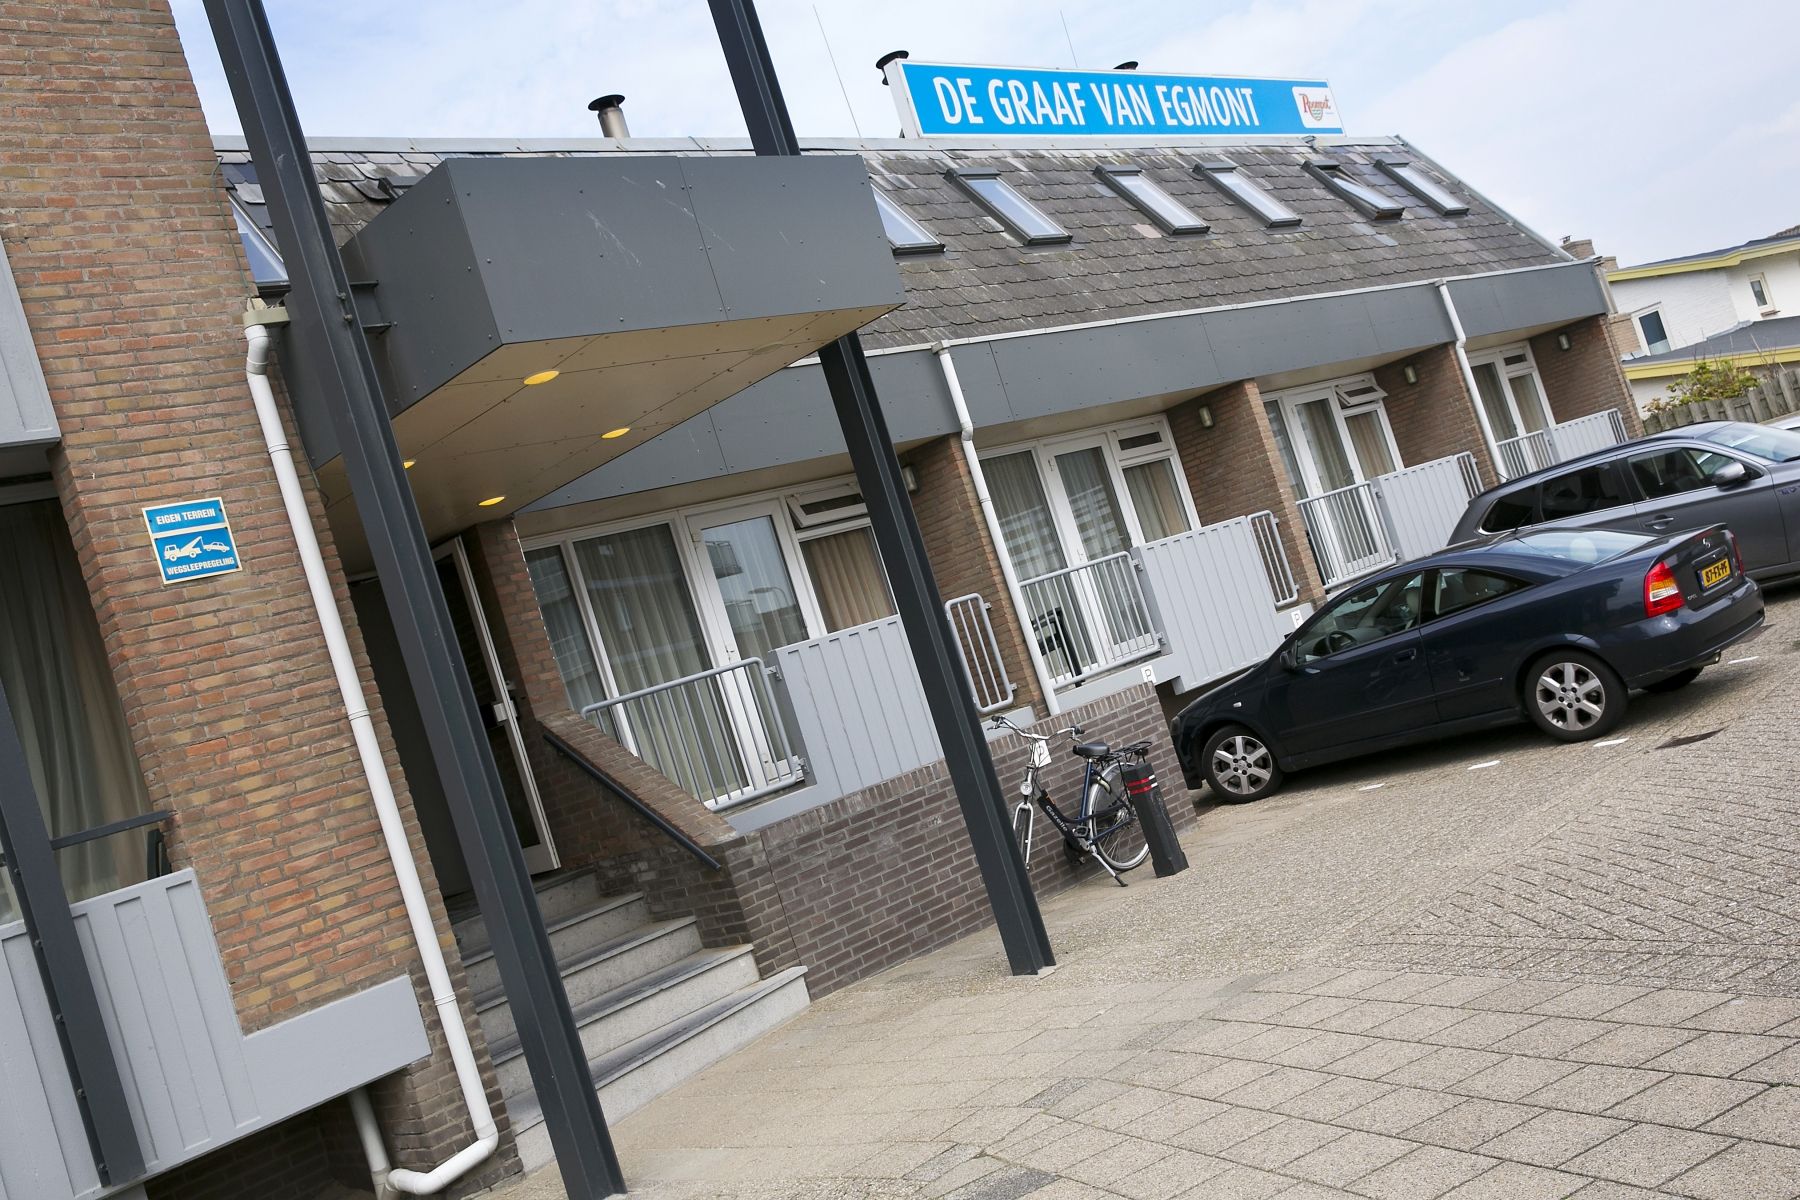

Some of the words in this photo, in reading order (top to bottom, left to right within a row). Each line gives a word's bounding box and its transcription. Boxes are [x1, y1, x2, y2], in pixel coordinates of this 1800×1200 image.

[933, 76, 984, 125] DE
[988, 79, 1086, 126] GRAAF
[1090, 83, 1156, 126] VAN
[1157, 84, 1260, 127] EGMONT
[156, 512, 182, 525] EIGEN
[181, 508, 216, 521] TERREIN
[166, 556, 235, 576] WEGSLEEPREGELING
[1045, 804, 1068, 832] Gazelle
